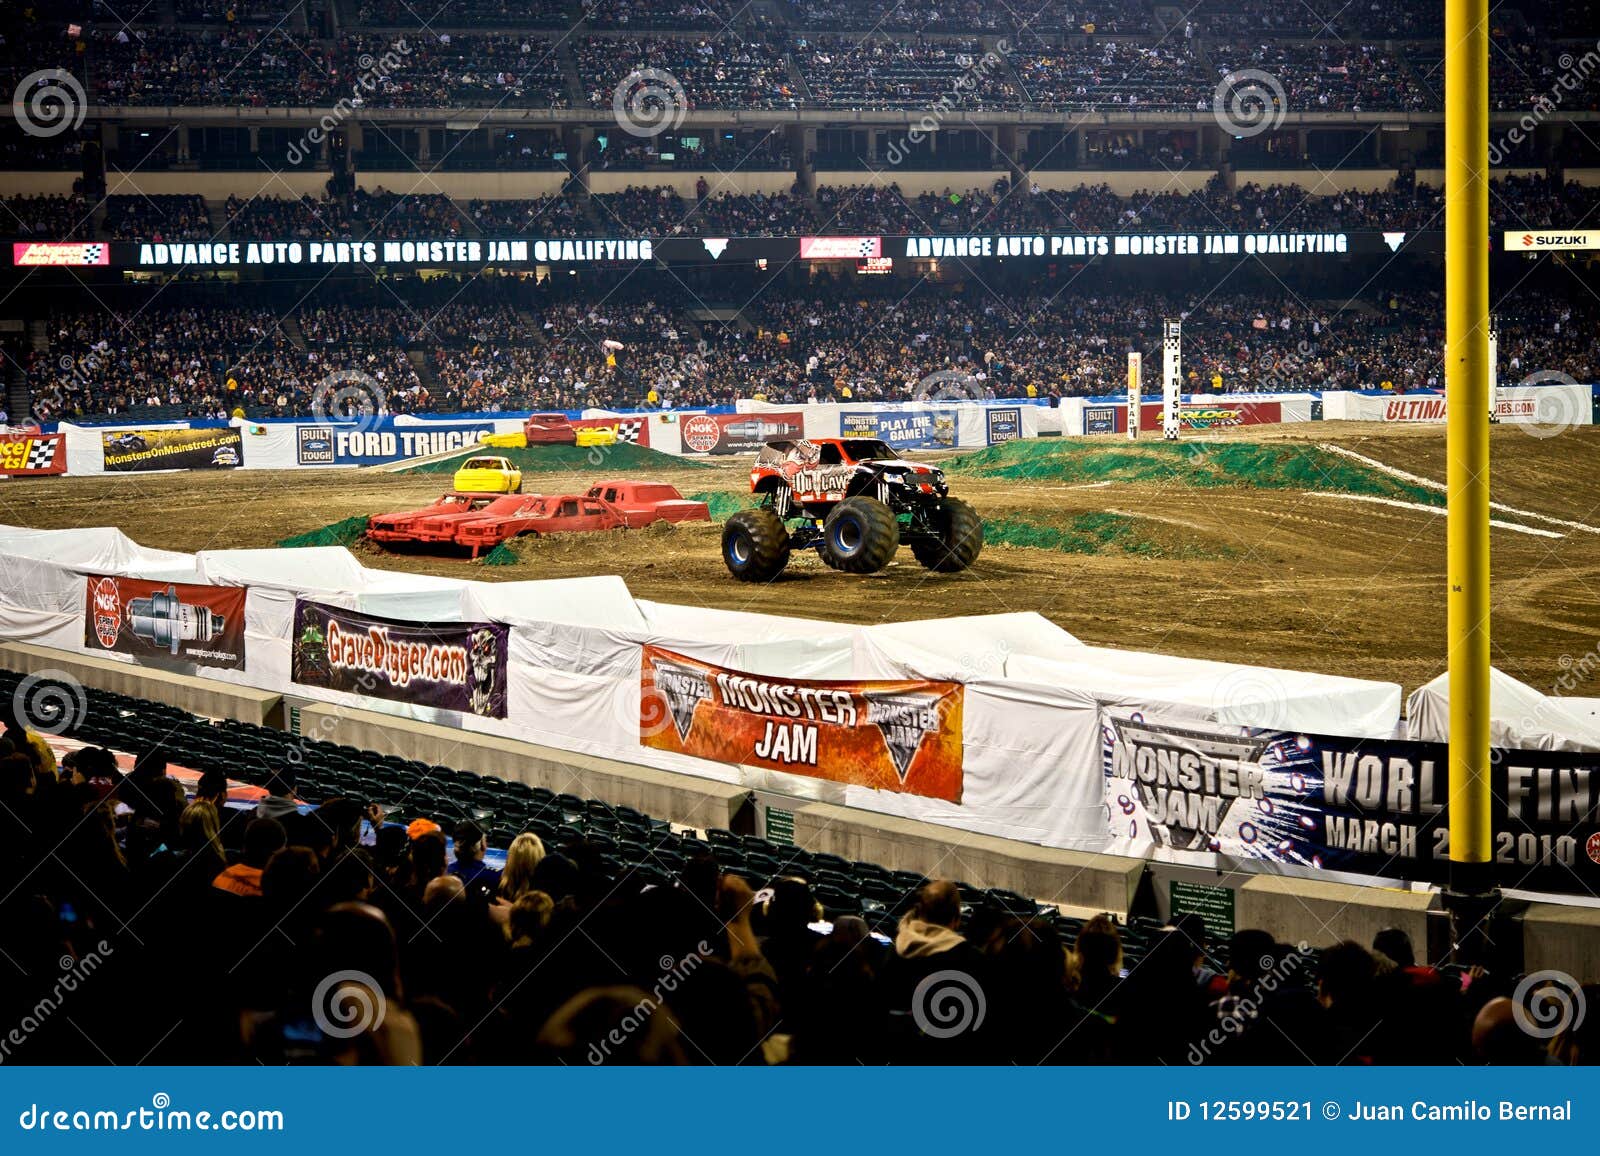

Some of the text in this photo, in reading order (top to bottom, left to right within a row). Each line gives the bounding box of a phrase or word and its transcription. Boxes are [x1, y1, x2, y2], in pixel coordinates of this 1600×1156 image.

[140, 239, 653, 265] ADVANCE AUTO PARTS MONSTER JAM QUALIFYING
[906, 233, 1347, 258] ADVANCE AUTO PARTS MONSTER JAM QUALIFYING
[1536, 236, 1587, 247] SUZUKI
[1172, 354, 1180, 421] FINISH
[991, 412, 1016, 422] BUILT
[1088, 410, 1112, 421] BUILT
[1495, 402, 1536, 414] IES.COM
[690, 424, 713, 433] NGK
[880, 416, 931, 431] PLAY THE
[301, 429, 331, 440] BUILT
[337, 431, 397, 457] FORD
[890, 428, 926, 441] GAME!
[992, 431, 1017, 441] TOUGH
[0, 441, 25, 456] ce
[104, 432, 241, 466] MonstersOnMainstreet.com
[302, 451, 332, 461] TOUGH
[0, 455, 21, 469] ts
[96, 593, 117, 612] NGK
[716, 673, 857, 727] MONSTER
[868, 701, 939, 731] MONSTER
[755, 720, 819, 766] JAM
[886, 725, 920, 748] JAM
[1112, 739, 1265, 801] MONSTER
[1321, 750, 1600, 824] WORL FIN
[1142, 786, 1226, 833] JAM
[1325, 815, 1577, 868] MARCH 2 2010
